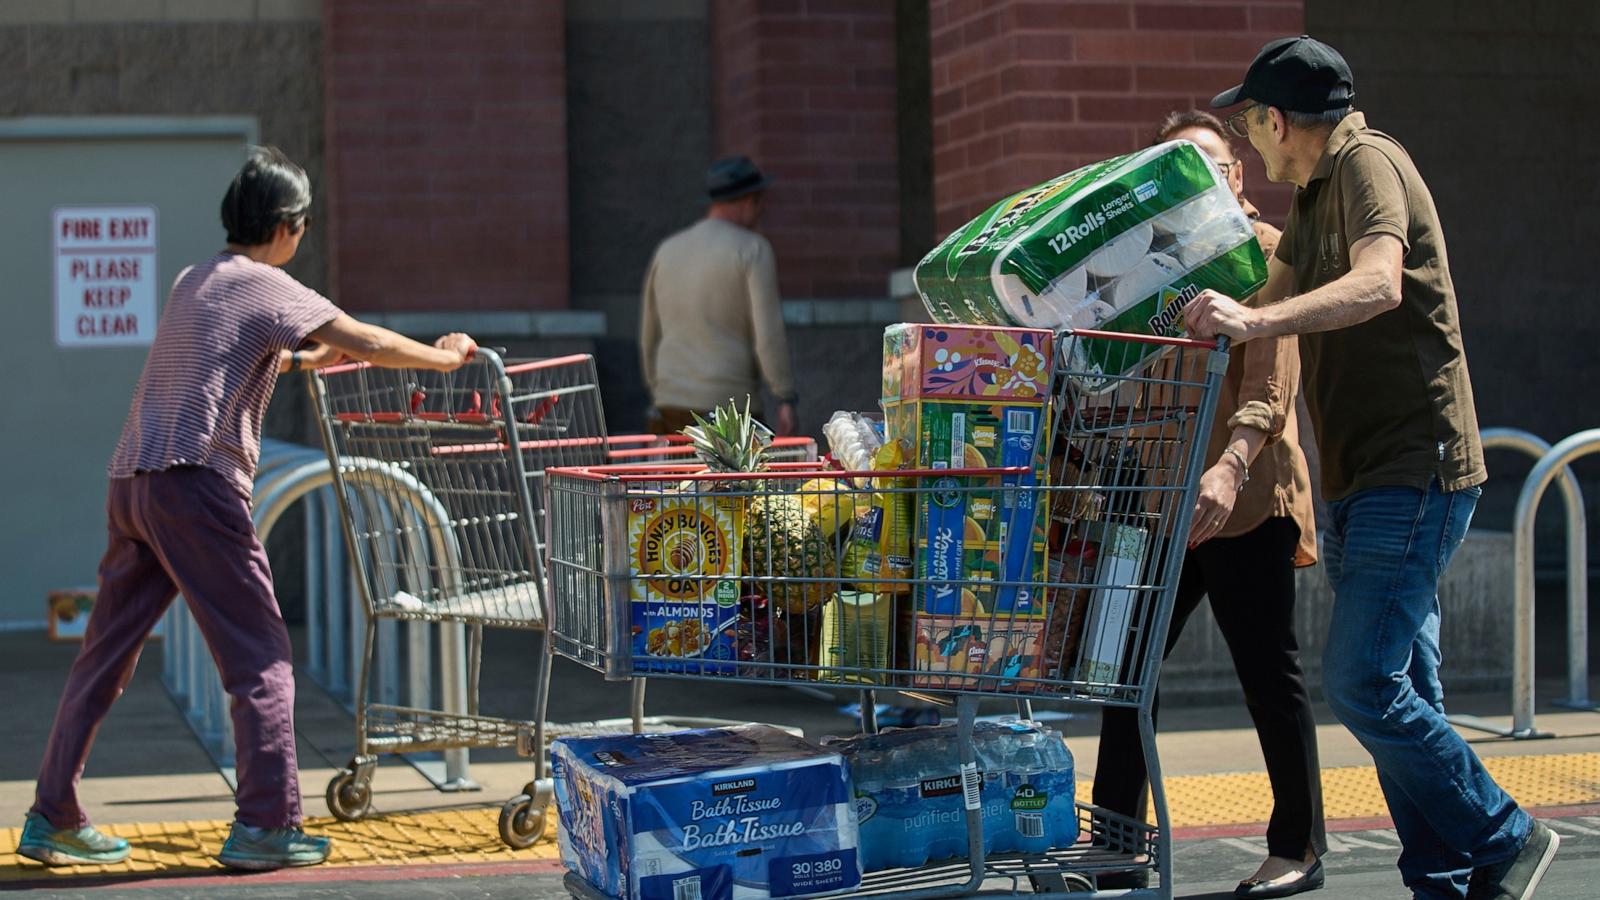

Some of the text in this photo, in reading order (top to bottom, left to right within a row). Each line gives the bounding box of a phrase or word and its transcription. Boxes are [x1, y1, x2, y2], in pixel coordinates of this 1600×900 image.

[1101, 192, 1131, 213] Longer
[1105, 200, 1135, 220] Sheets
[62, 218, 149, 239] FIRE EXIT
[70, 258, 141, 280] PLEASE
[83, 287, 132, 308] KEEP
[76, 313, 139, 336] CLEAR
[632, 499, 652, 512] Post
[647, 514, 721, 565] HONEY BUNCHES
[723, 581, 730, 590] 2
[657, 606, 714, 618] ALMONDS
[714, 778, 755, 792] KIRKLAND
[1013, 798, 1046, 808] BOTTLES
[903, 803, 1005, 832] purified ater
[792, 862, 811, 875] 30
[814, 858, 842, 873] 380
[792, 876, 843, 888] WIDE SHEETS
